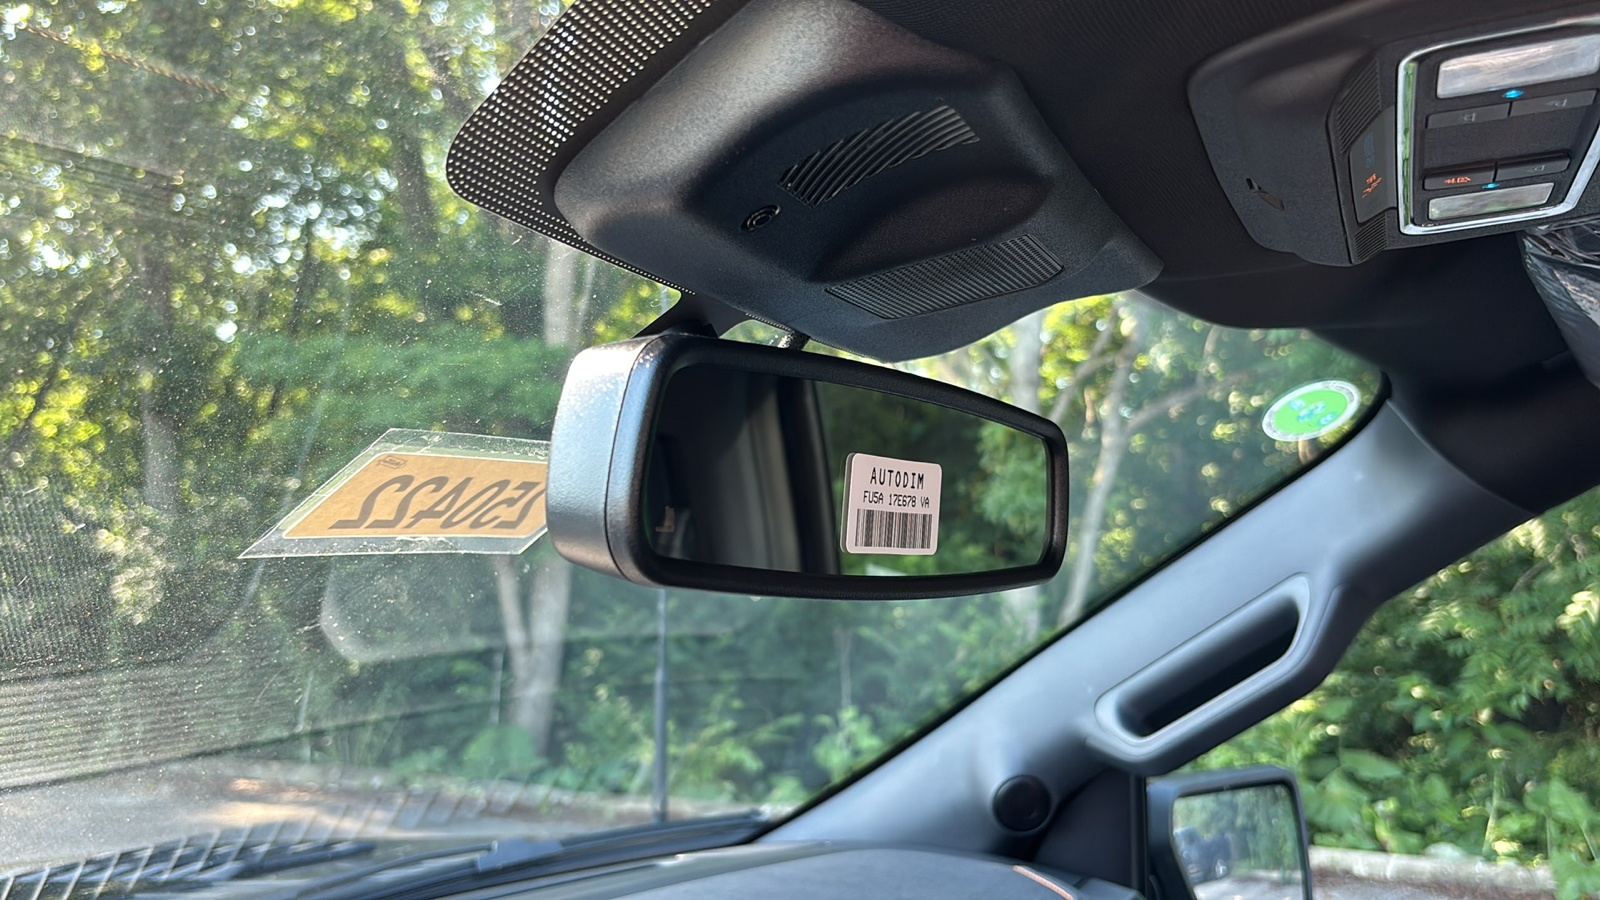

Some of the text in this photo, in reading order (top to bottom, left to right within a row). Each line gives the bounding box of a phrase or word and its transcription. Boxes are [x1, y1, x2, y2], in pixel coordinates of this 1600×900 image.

[870, 467, 925, 490] AUTODIM
[863, 490, 930, 509] FU5A 17E678 VA
